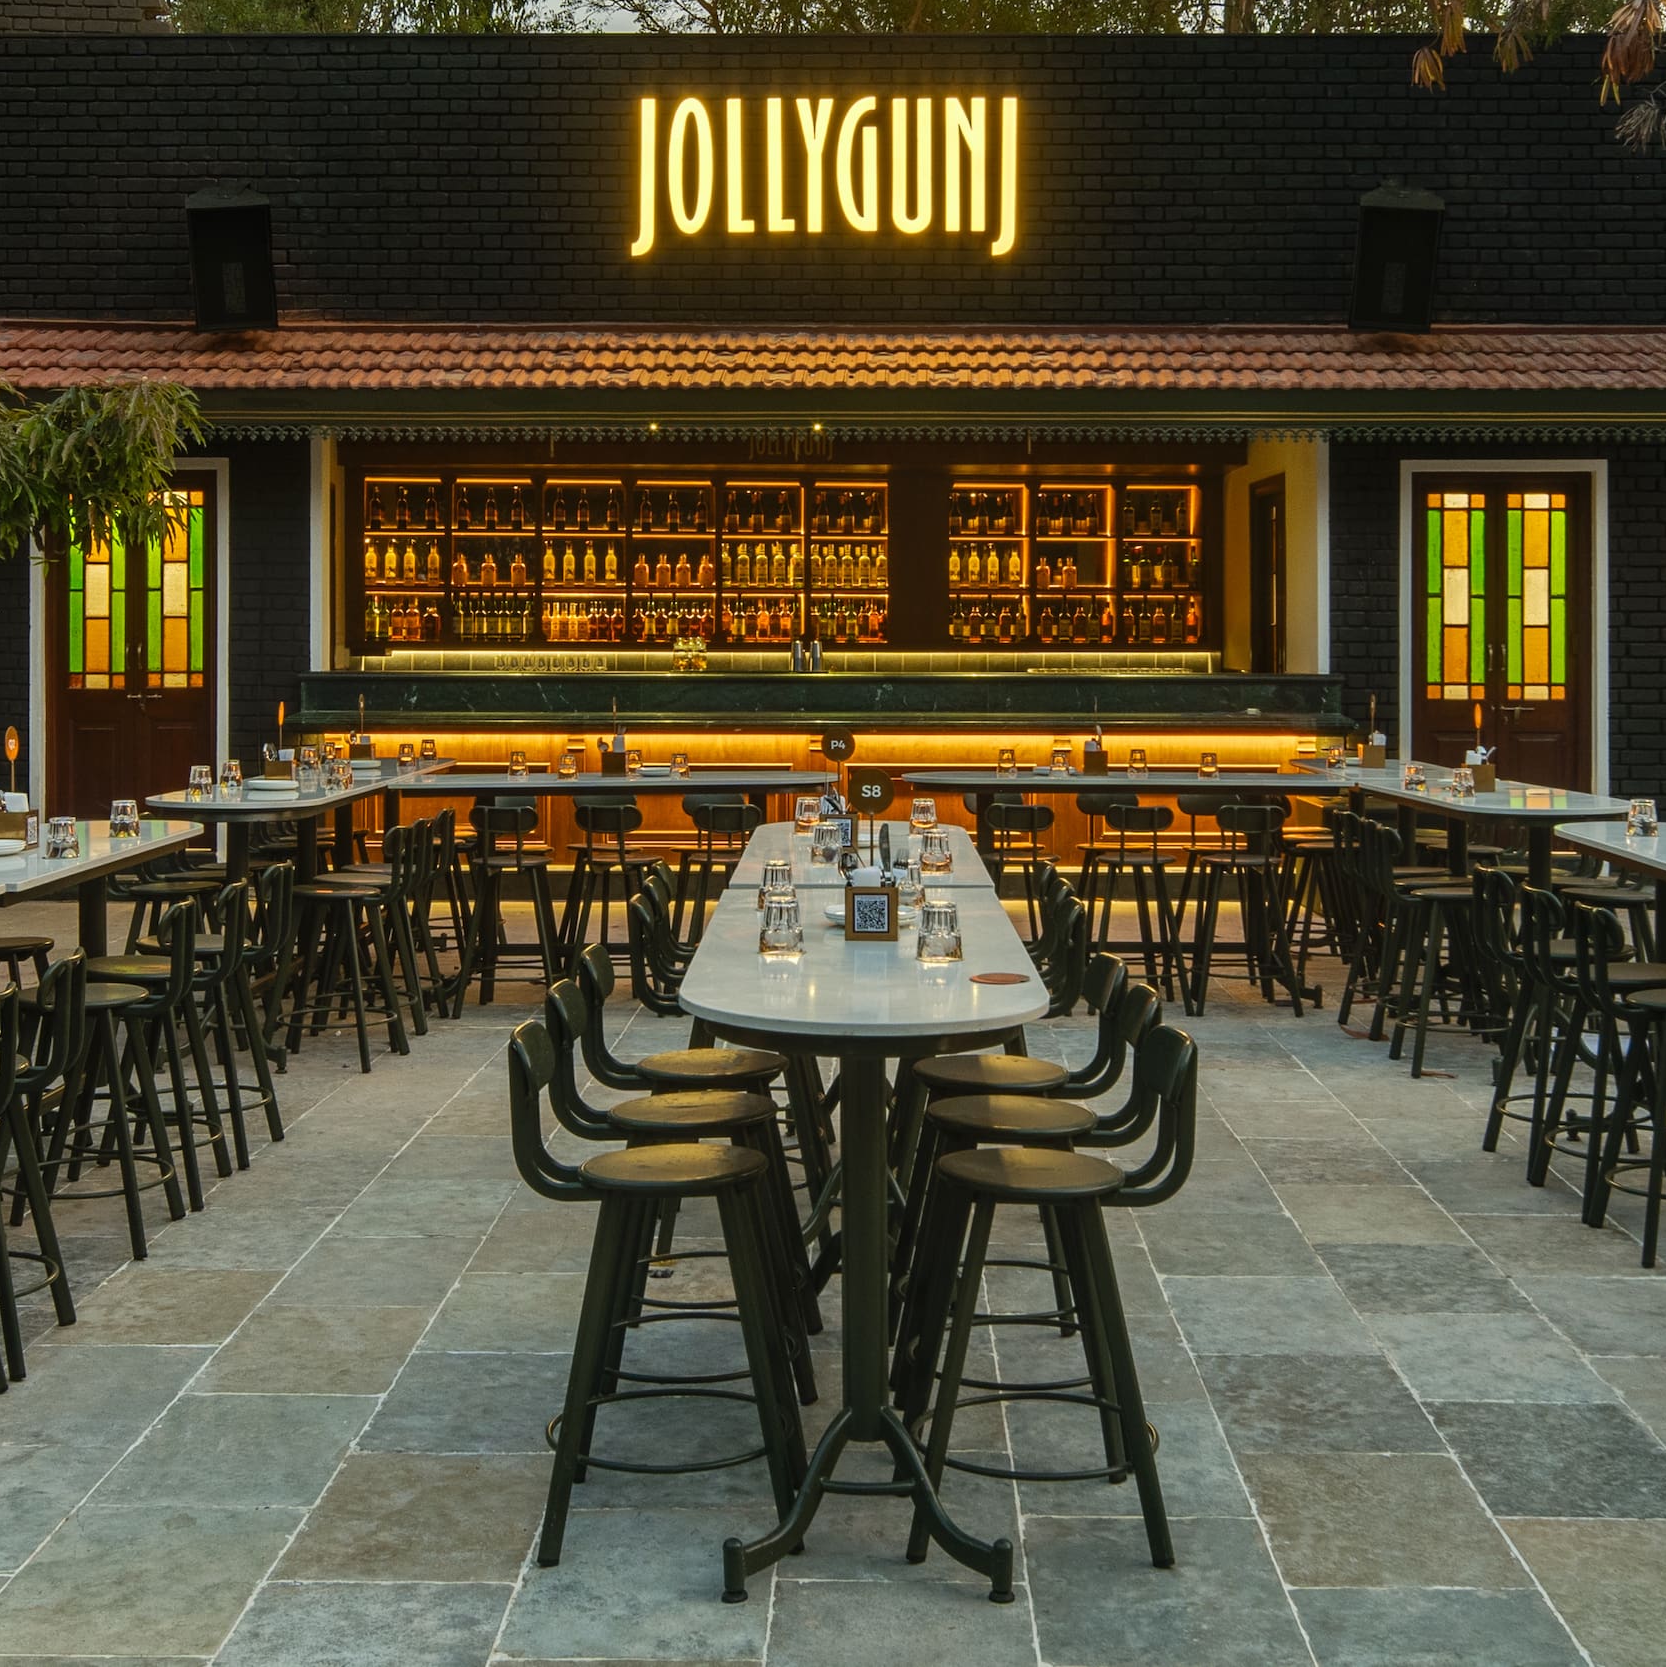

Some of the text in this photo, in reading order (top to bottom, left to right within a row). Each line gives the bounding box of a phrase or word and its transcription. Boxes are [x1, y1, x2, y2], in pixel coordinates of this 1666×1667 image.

[631, 96, 1018, 256] JOLLYGUNJ
[830, 740, 846, 750] P4
[861, 784, 882, 798] S8
